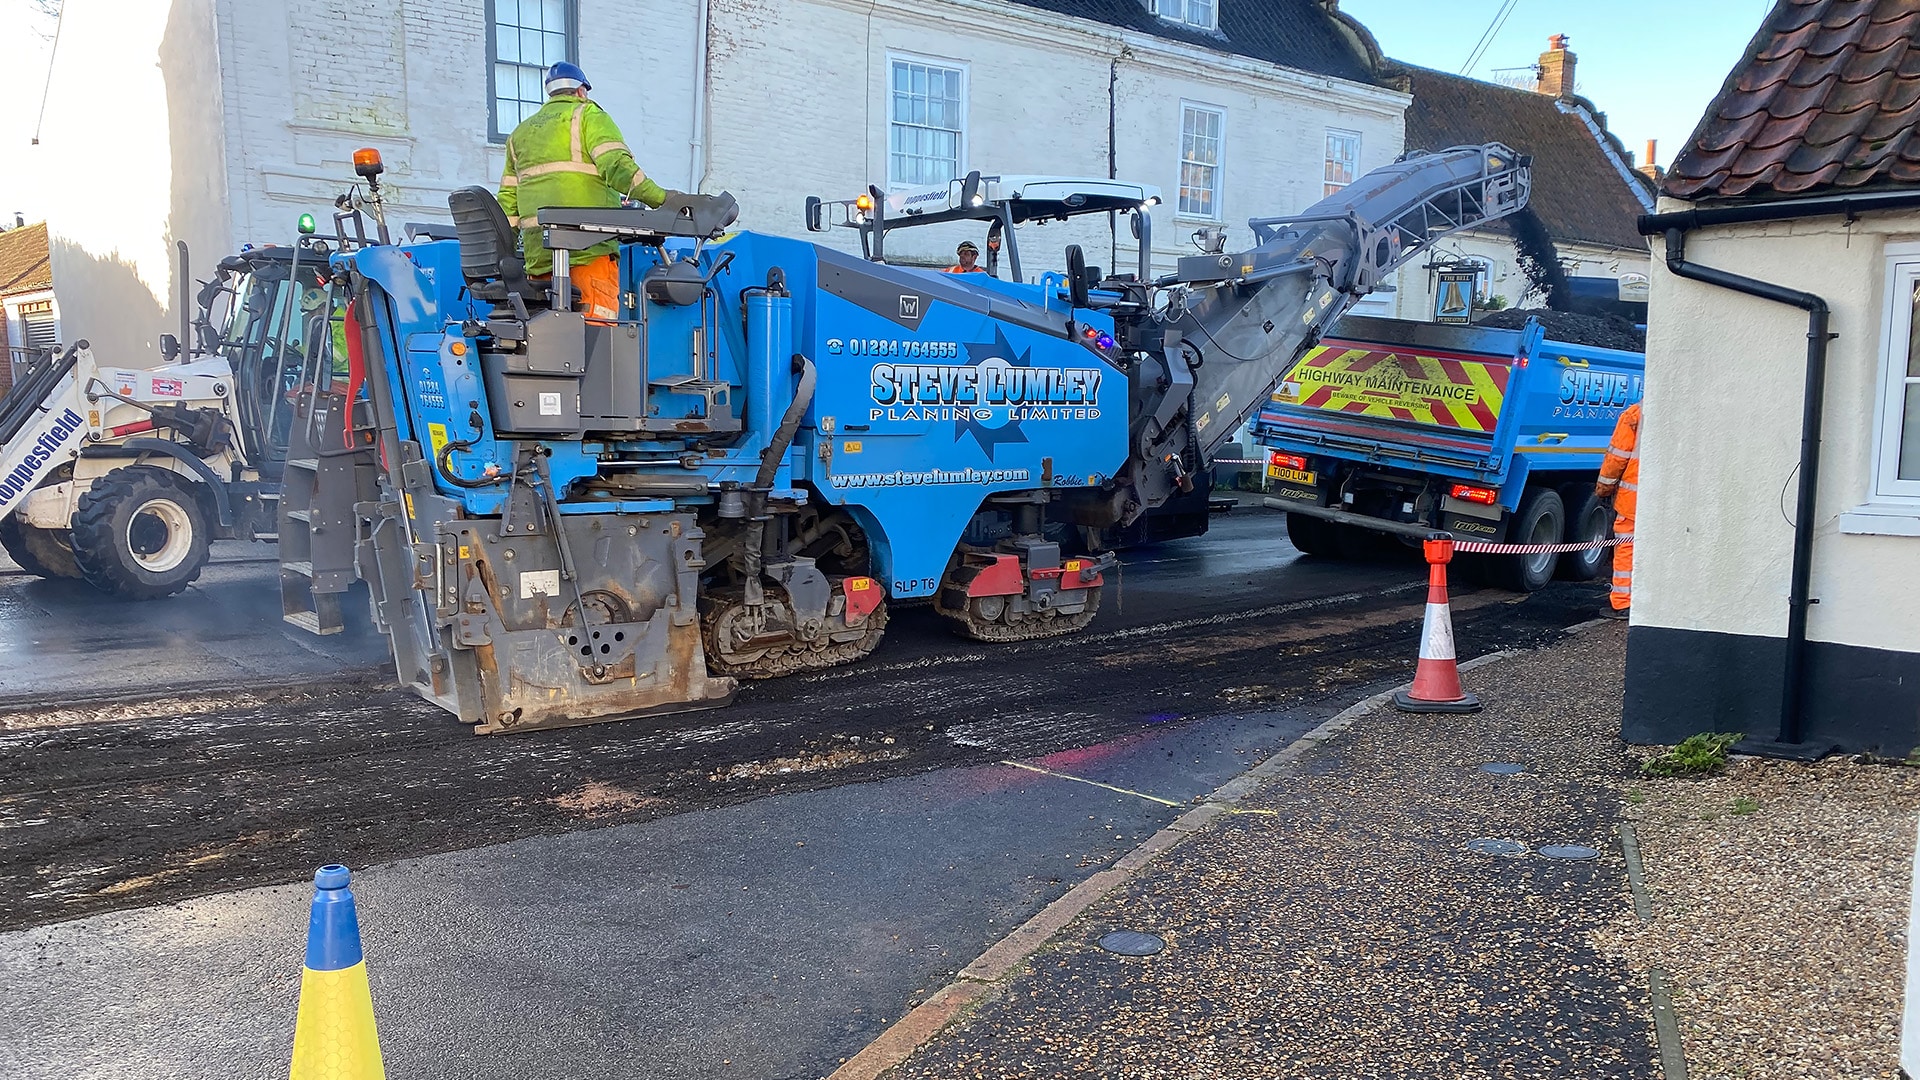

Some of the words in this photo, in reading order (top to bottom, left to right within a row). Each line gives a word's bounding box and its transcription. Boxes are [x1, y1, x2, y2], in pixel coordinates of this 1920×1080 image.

[849, 338, 898, 356] 01284
[902, 340, 958, 358] 764555
[419, 380, 441, 394] 01284
[871, 363, 979, 406] STEVE
[984, 367, 1102, 406] LUMLEY
[1299, 368, 1362, 387] HIGHWAY
[1365, 376, 1476, 401] MAINTENANCE
[1560, 367, 1628, 408] STEVE
[1332, 392, 1357, 400] BEWARE
[1368, 397, 1394, 405] VEHICLE
[1394, 400, 1430, 410] REVERSING
[870, 408, 992, 421] PLANING
[1008, 409, 1101, 420] LIMITED
[1553, 407, 1620, 419] PLANIN
[831, 467, 1030, 488] www.stevelumley.com
[1273, 467, 1290, 478] T100
[894, 579, 918, 592] SLP
[921, 578, 935, 590] T6
